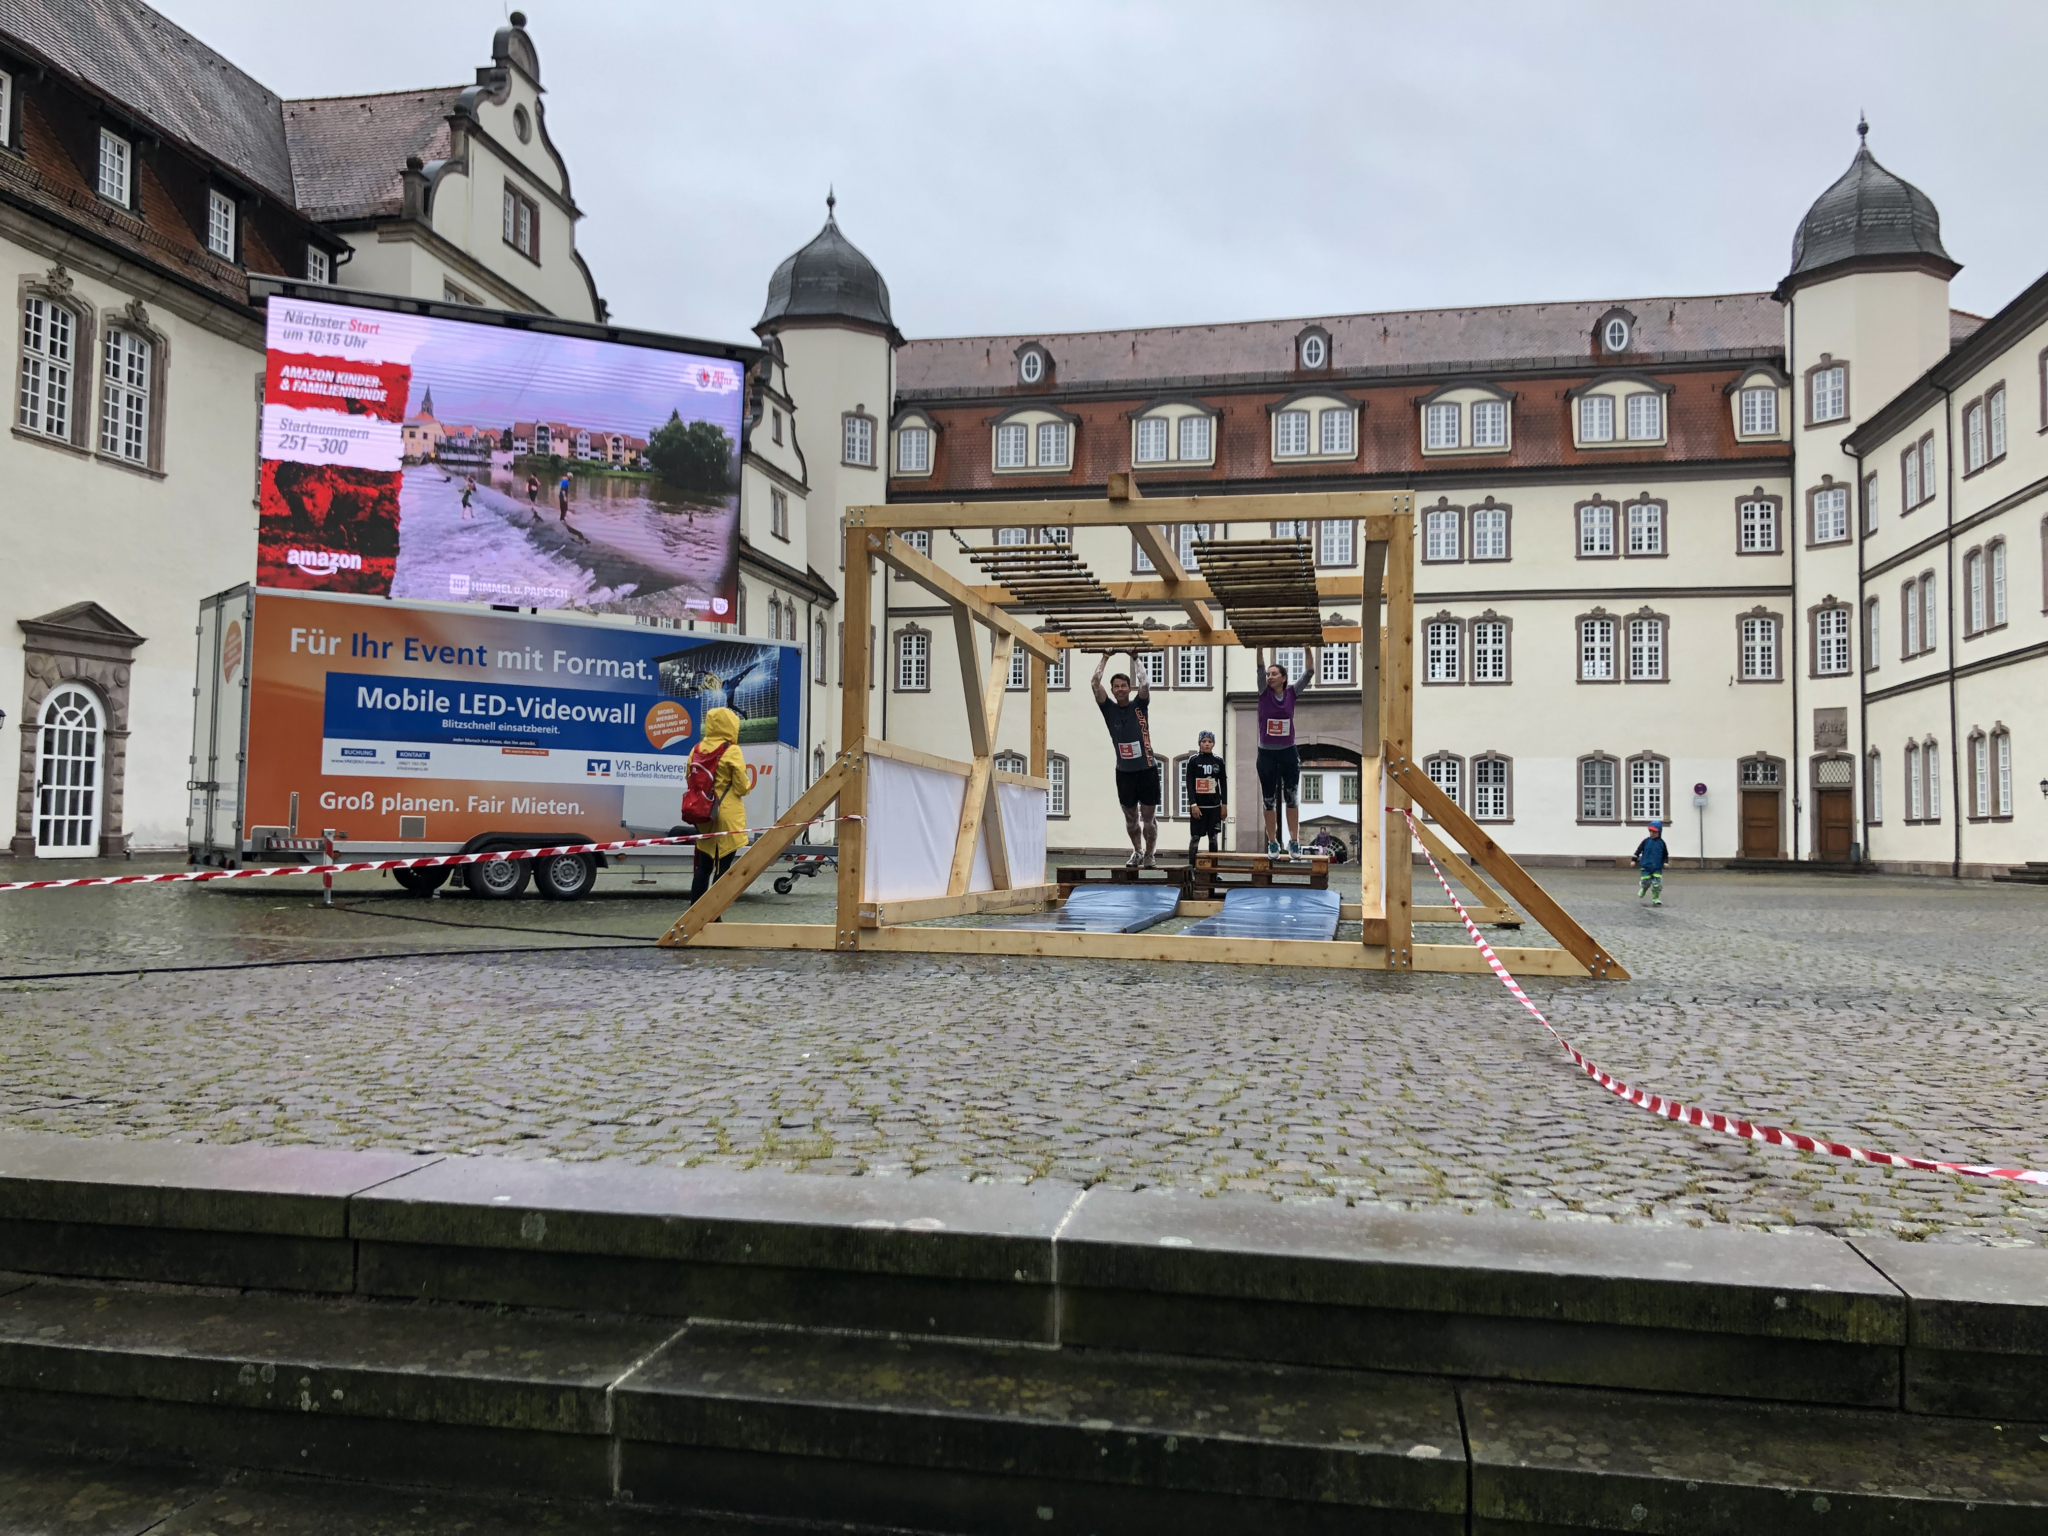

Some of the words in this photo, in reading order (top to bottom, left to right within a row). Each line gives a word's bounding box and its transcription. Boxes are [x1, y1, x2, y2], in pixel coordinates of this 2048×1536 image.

[284, 310, 346, 330] Nächster
[348, 318, 380, 335] Start
[283, 329, 303, 341] um
[308, 330, 341, 345] 10:15
[344, 334, 368, 349] Uhr
[280, 365, 335, 383] AMAZON
[335, 371, 383, 388] KINDER-
[279, 378, 290, 391] &
[292, 379, 388, 402] FAMILIENRUNDE
[280, 418, 370, 439] Startnummern
[287, 549, 362, 570] amazon
[471, 581, 512, 594] HIMMEL
[524, 586, 568, 598] PAPESCH
[290, 627, 342, 655] Für
[351, 632, 393, 659] Ihr
[404, 637, 487, 667] Event
[497, 646, 543, 672] mit
[553, 650, 653, 681] Format.
[357, 686, 450, 713] Mobile
[459, 693, 636, 724] LED-Videowall
[442, 718, 496, 731] Blitzschnell
[498, 722, 560, 734] einsatzbereit.
[656, 714, 678, 722] WERBEN
[662, 726, 685, 734] WOLLEN!
[616, 760, 686, 774] VR-Bankverei
[628, 772, 683, 781] Hersfeld-Rotenburg
[1202, 764, 1213, 775] 10
[319, 791, 375, 810] Groß
[381, 792, 460, 815] planen.
[467, 795, 506, 814] Fair
[511, 796, 585, 815] Mieten.
